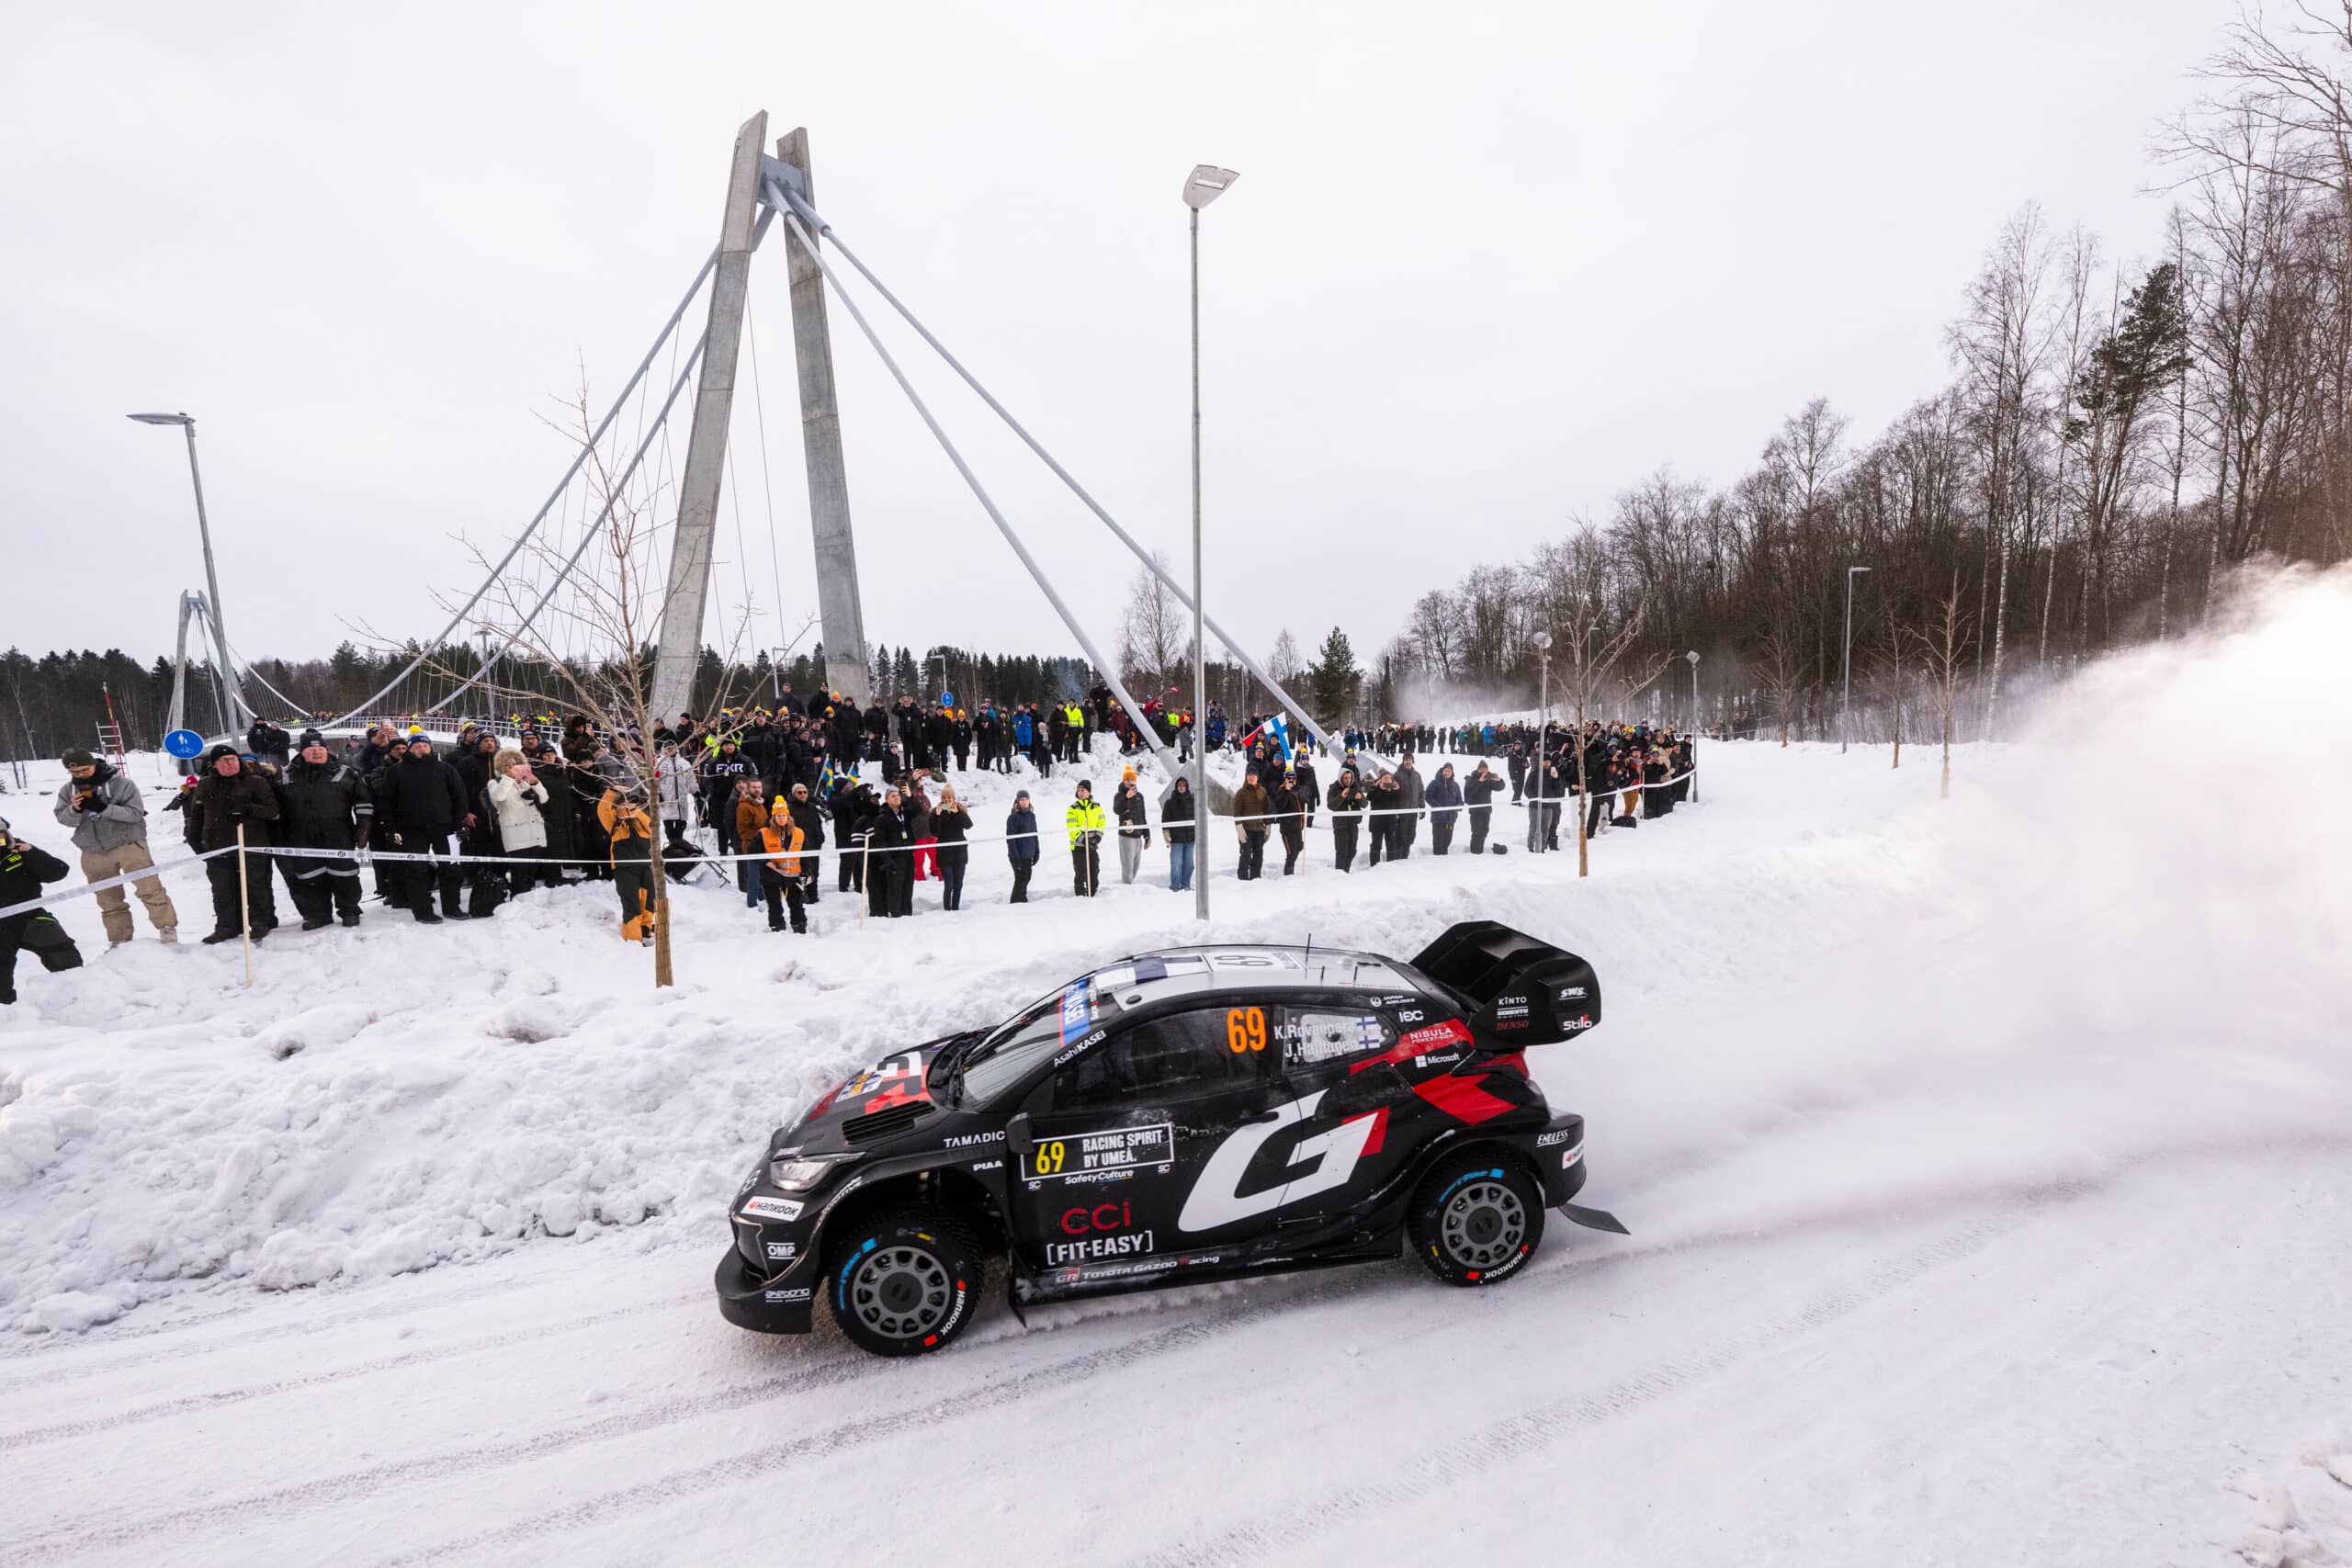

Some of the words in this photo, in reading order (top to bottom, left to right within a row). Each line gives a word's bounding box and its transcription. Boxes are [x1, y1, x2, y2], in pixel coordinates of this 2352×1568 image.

[717, 763, 743, 773] FXR
[1498, 997, 1527, 1006] KINTO
[1227, 1007, 1266, 1053] 69
[1563, 1014, 1592, 1031] Stilo
[1410, 1028, 1453, 1040] NISULA
[1427, 1053, 1460, 1064] Microsoft
[944, 1131, 1006, 1148] TAMADIC
[1082, 1134, 1125, 1152] RACING
[1126, 1130, 1163, 1147] SPIRIT
[973, 1160, 1003, 1171] PIAA
[1035, 1142, 1065, 1174] 69
[1083, 1153, 1099, 1168] BY
[767, 1246, 796, 1257] OMP
[1082, 1268, 1131, 1280] TOYOTA
[1133, 1261, 1177, 1272] GAZOO
